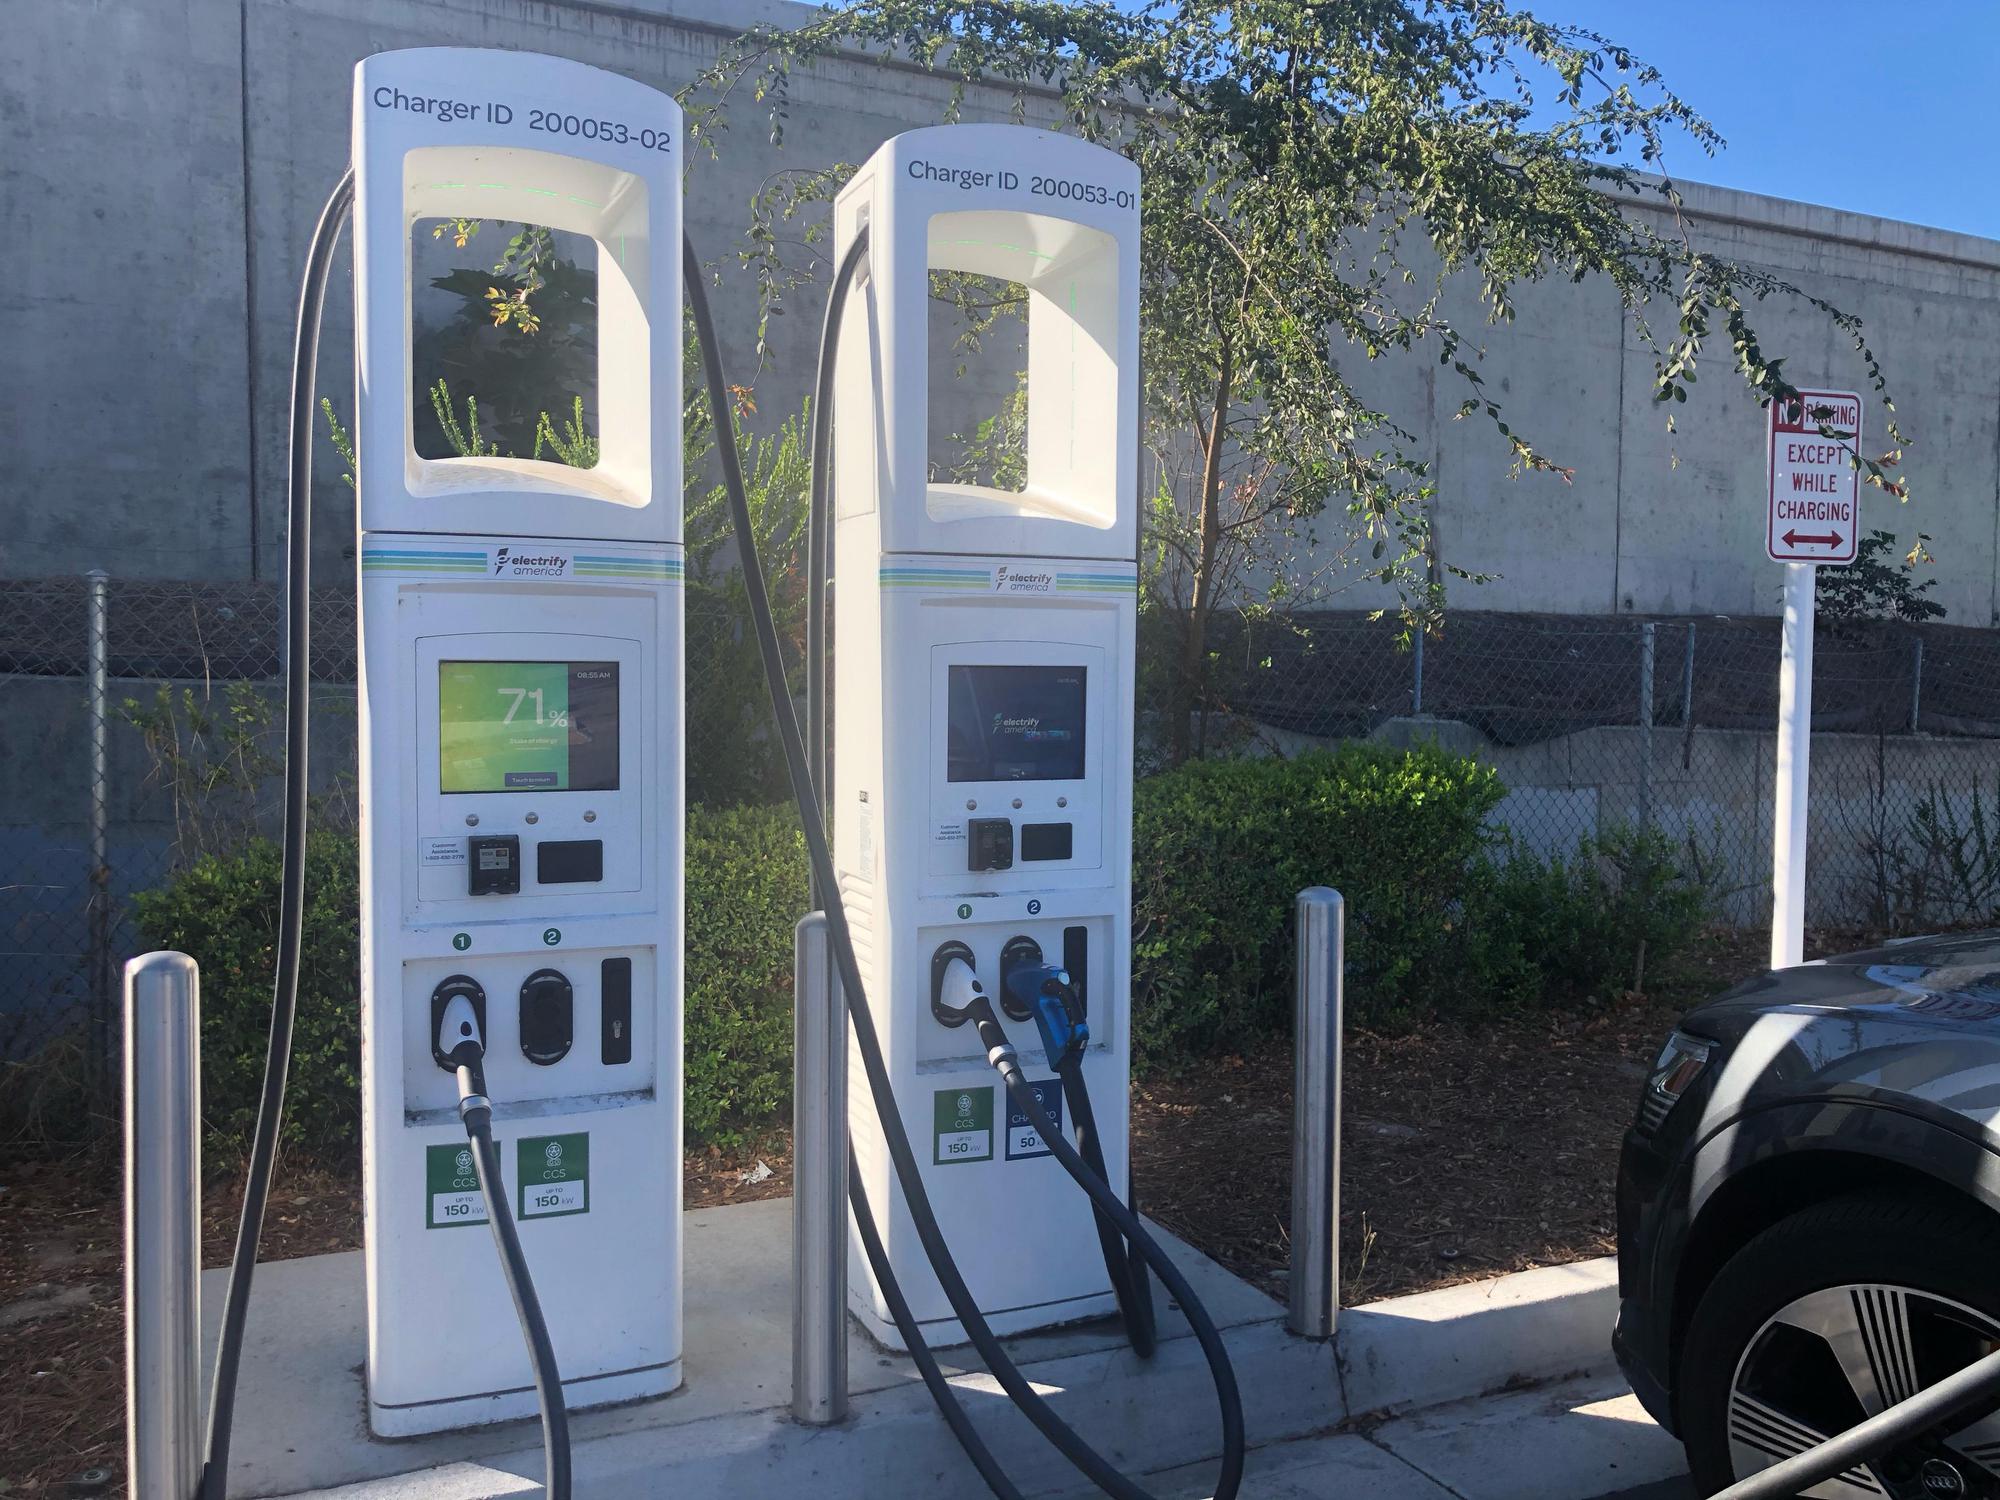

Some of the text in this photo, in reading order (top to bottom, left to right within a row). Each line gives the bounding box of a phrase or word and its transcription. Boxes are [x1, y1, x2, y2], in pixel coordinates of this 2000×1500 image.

[373, 86, 671, 153] Charger ID 200053-02
[908, 160, 1135, 210] Charger ID 200053-01
[1788, 443, 1845, 465] EXCEPT
[1792, 472, 1837, 493] WHILE
[1777, 500, 1850, 522] CHARGING
[512, 555, 567, 568] electrify
[513, 566, 563, 577] america
[1009, 573, 1052, 585] electrify
[1010, 582, 1049, 592] america
[1003, 717, 1039, 727] electrify
[955, 1119, 975, 1129] CCS
[947, 1142, 969, 1154] 150
[1020, 1136, 1036, 1148] 50
[543, 1169, 566, 1180] CCS
[453, 1178, 477, 1188] CCS
[535, 1195, 560, 1208] 150
[444, 1204, 470, 1216] 150
